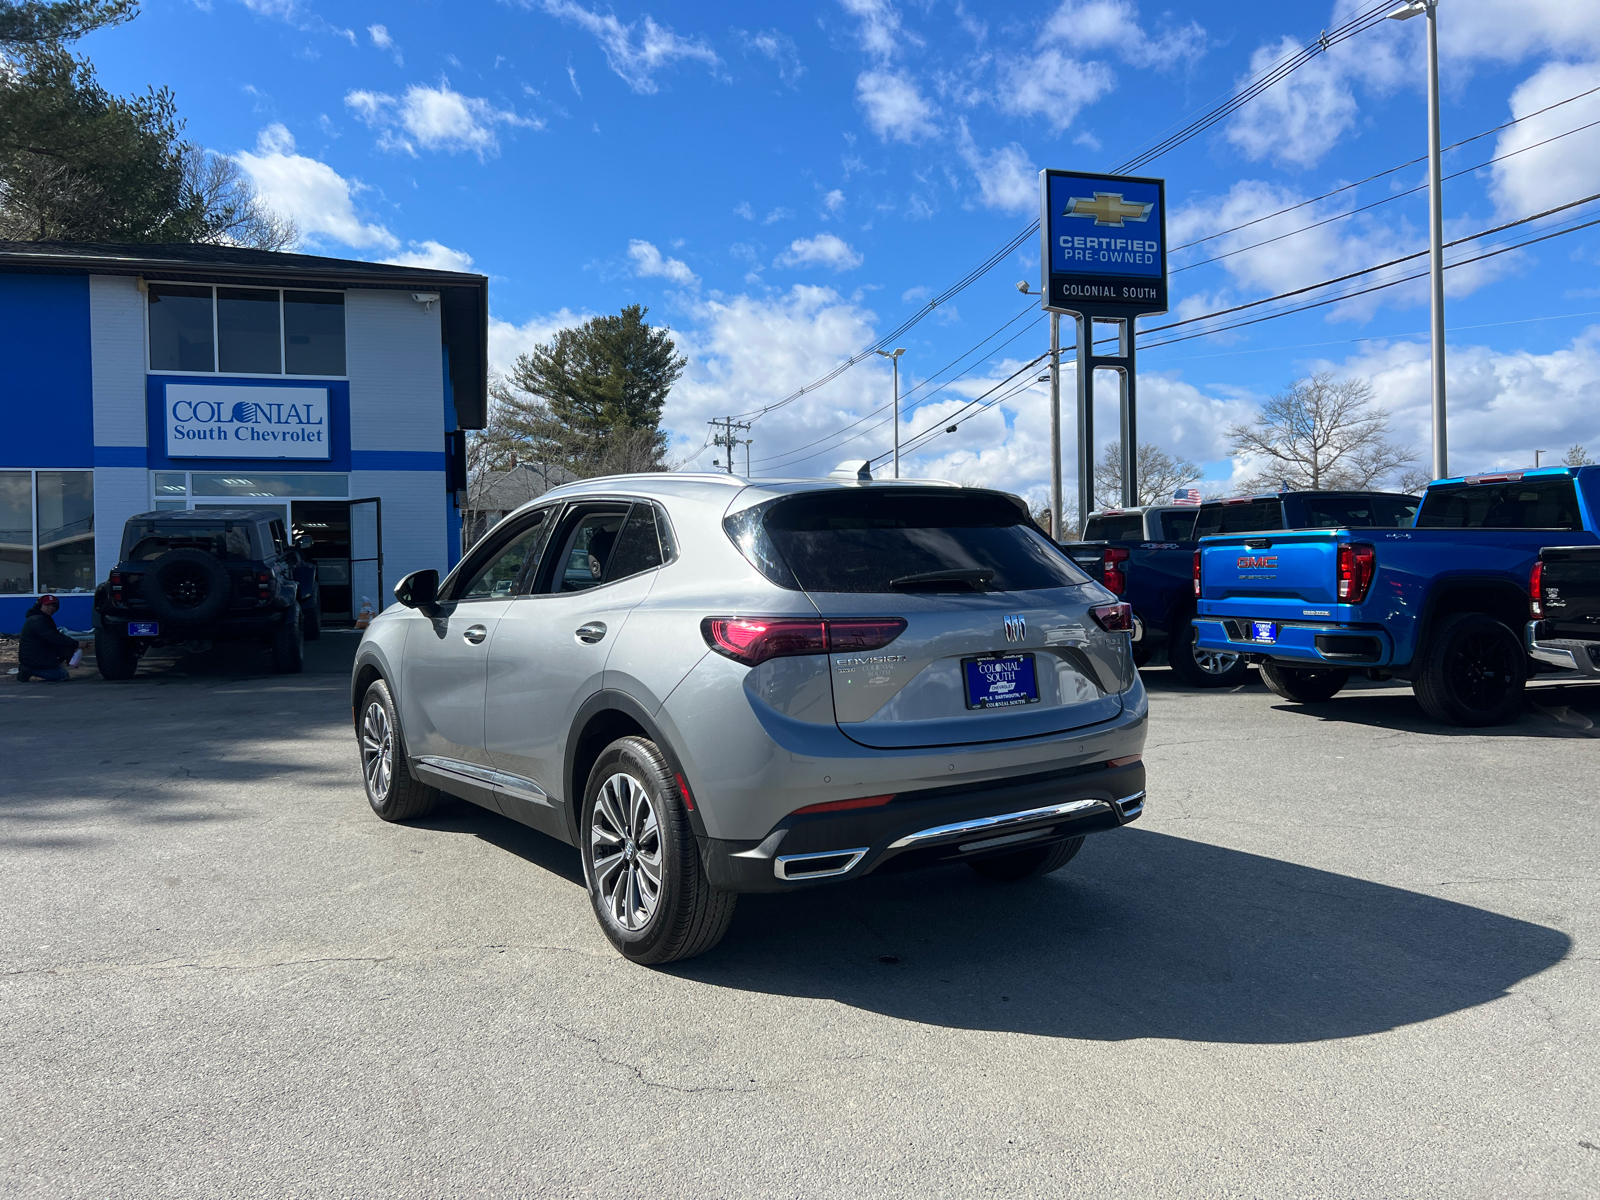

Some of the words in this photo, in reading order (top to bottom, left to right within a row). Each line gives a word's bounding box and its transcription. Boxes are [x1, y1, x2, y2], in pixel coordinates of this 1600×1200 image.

[1059, 235, 1158, 252] CERTIFIED
[1064, 249, 1153, 265] PRE-OWNED
[1063, 284, 1116, 297] COLONIAL
[1122, 286, 1157, 299] SOUTH
[172, 400, 323, 425] COLONIAL
[173, 424, 228, 441] South
[234, 426, 323, 442] Chevrolet
[1237, 556, 1278, 570] GMC
[979, 662, 1020, 673] COLONIAL
[986, 671, 1015, 682] SOUTH
[621, 750, 653, 787] Continental
